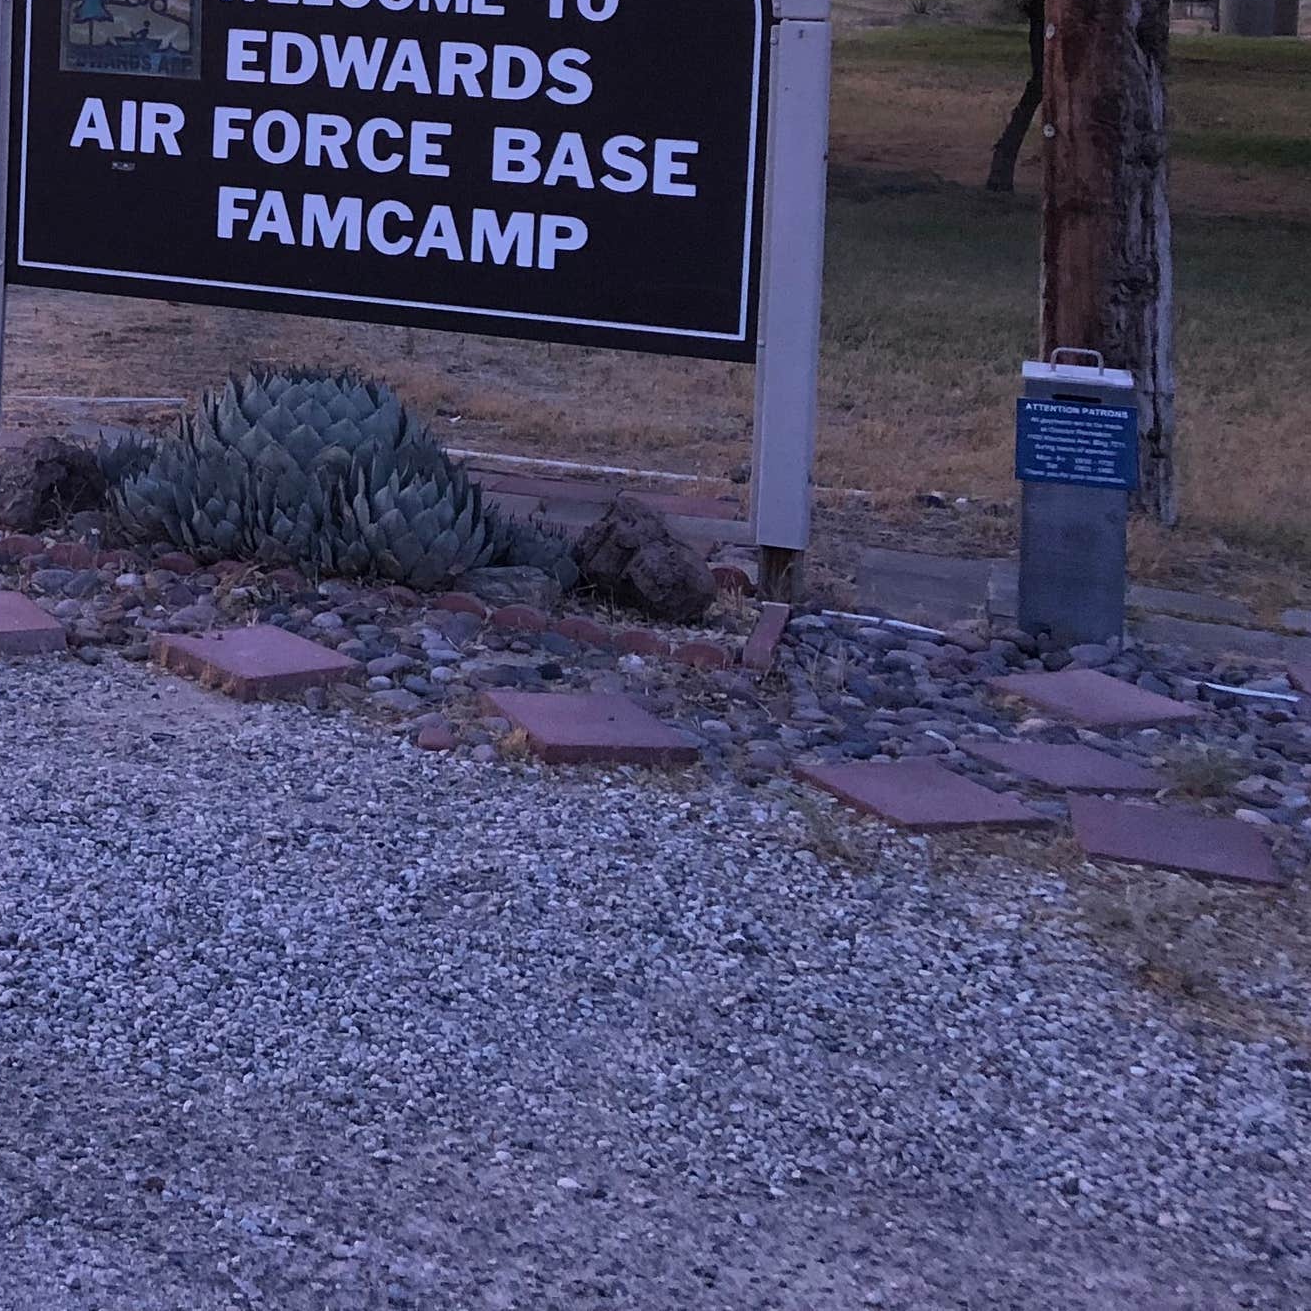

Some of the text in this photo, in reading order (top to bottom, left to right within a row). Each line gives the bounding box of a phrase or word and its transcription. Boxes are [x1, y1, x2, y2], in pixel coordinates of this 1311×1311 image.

[226, 28, 594, 105] EDWARDS
[69, 97, 699, 197] AIR FORCE BASE
[216, 186, 589, 270] FAMCAMP
[1025, 403, 1129, 419] ATTENTION PATRONS
